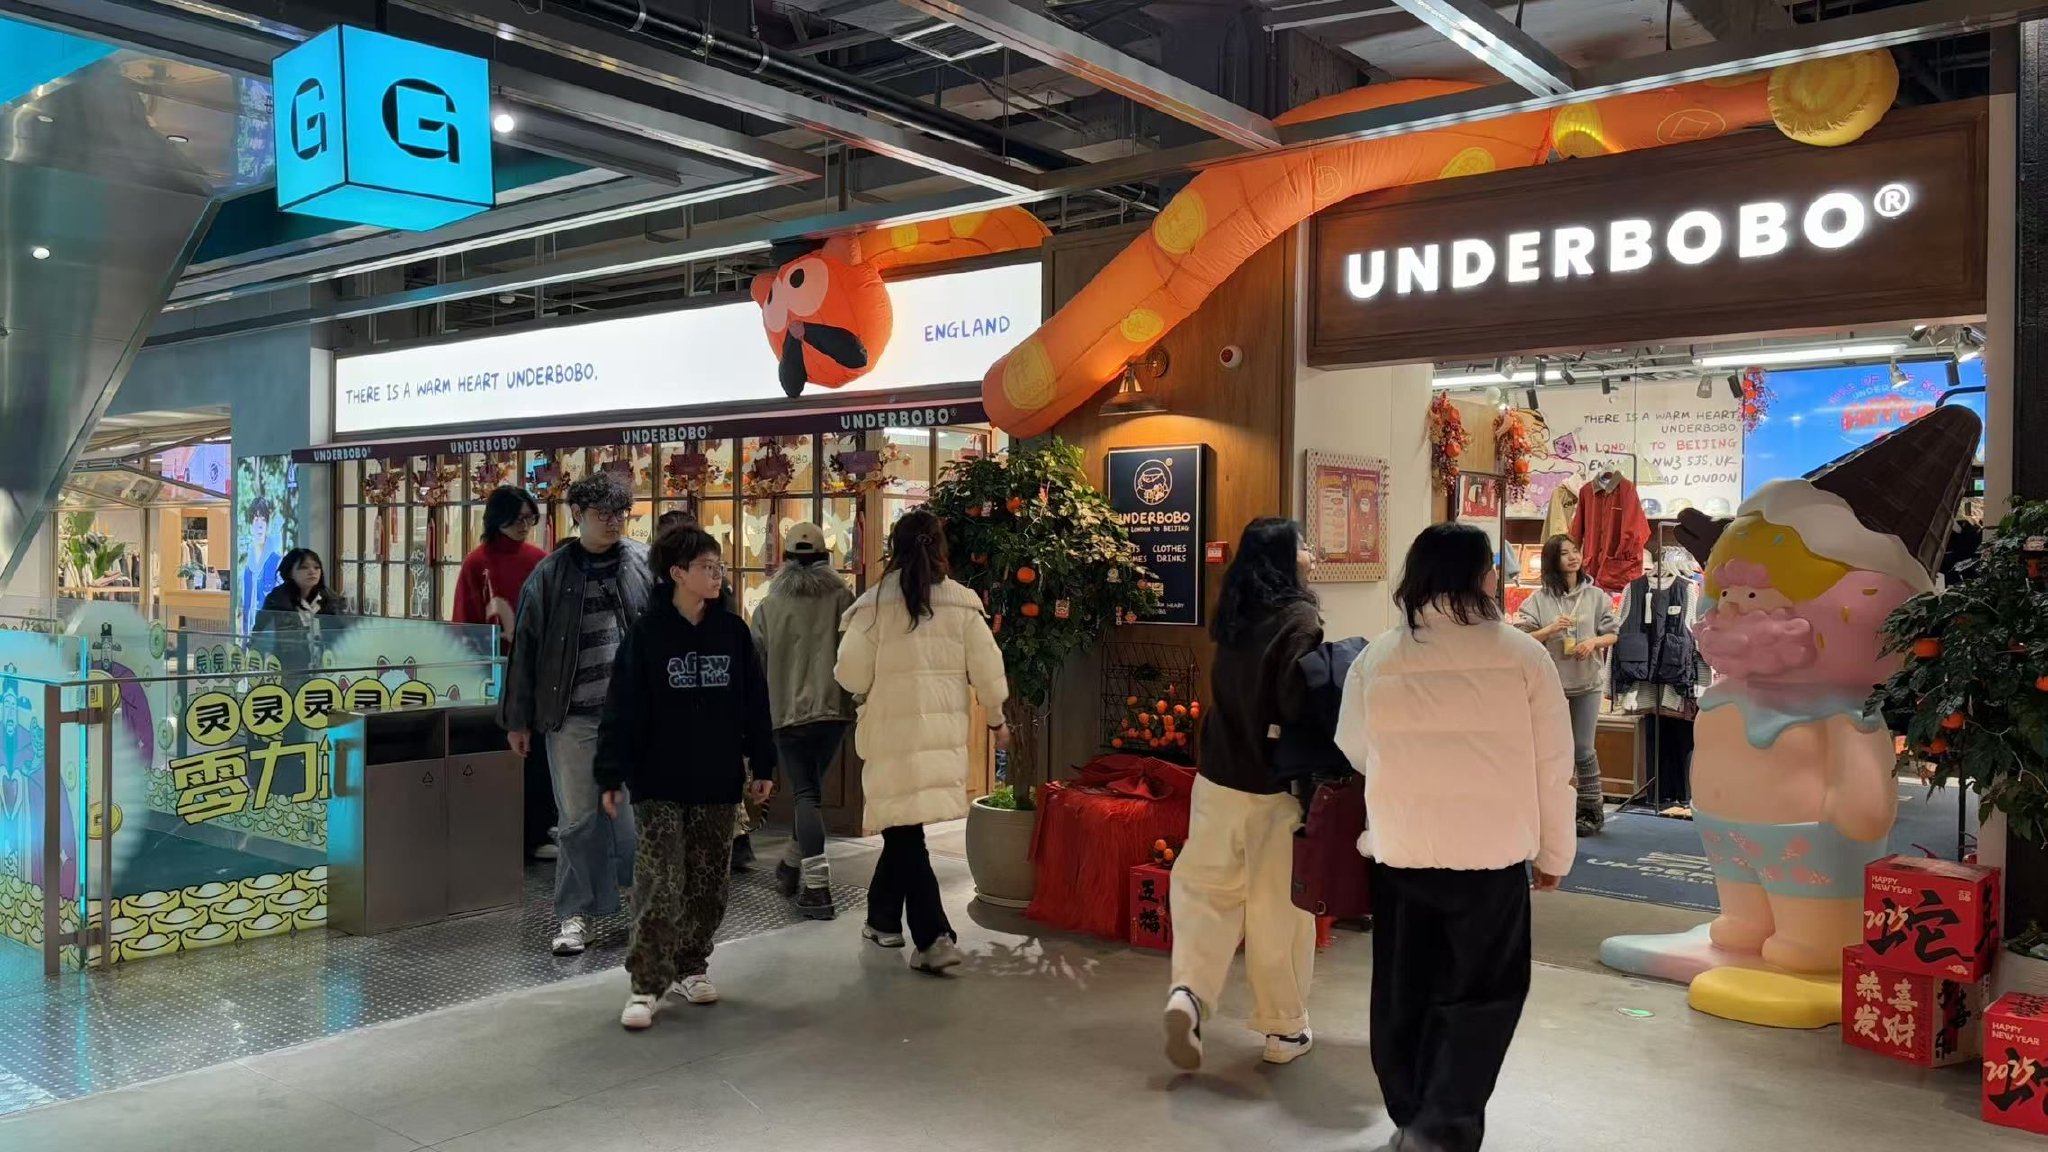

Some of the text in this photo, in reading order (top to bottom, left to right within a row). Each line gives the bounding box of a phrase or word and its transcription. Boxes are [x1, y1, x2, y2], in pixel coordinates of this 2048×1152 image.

[382, 78, 460, 164] G
[924, 316, 1010, 342] ENGLAND
[346, 363, 598, 404] THERE IS A WARM HEART UNDERBOBO.
[1584, 414, 1620, 423] THERE
[1626, 413, 1637, 422] IS
[1642, 412, 1649, 420] A
[1656, 411, 1690, 420] WARM
[1650, 441, 1666, 450] TO
[1676, 440, 1738, 450] BEIJING
[1715, 455, 1739, 466] UK
[1684, 474, 1738, 485] LONDON
[1152, 544, 1187, 553] CLOTHES
[1156, 554, 1187, 563] DRINKS
[1871, 875, 1898, 885] HAPPY
[1871, 883, 1912, 895] NEW YEAR
[1992, 1021, 2022, 1034] HAPPY
[1992, 1030, 2040, 1046] NEW YEAR
